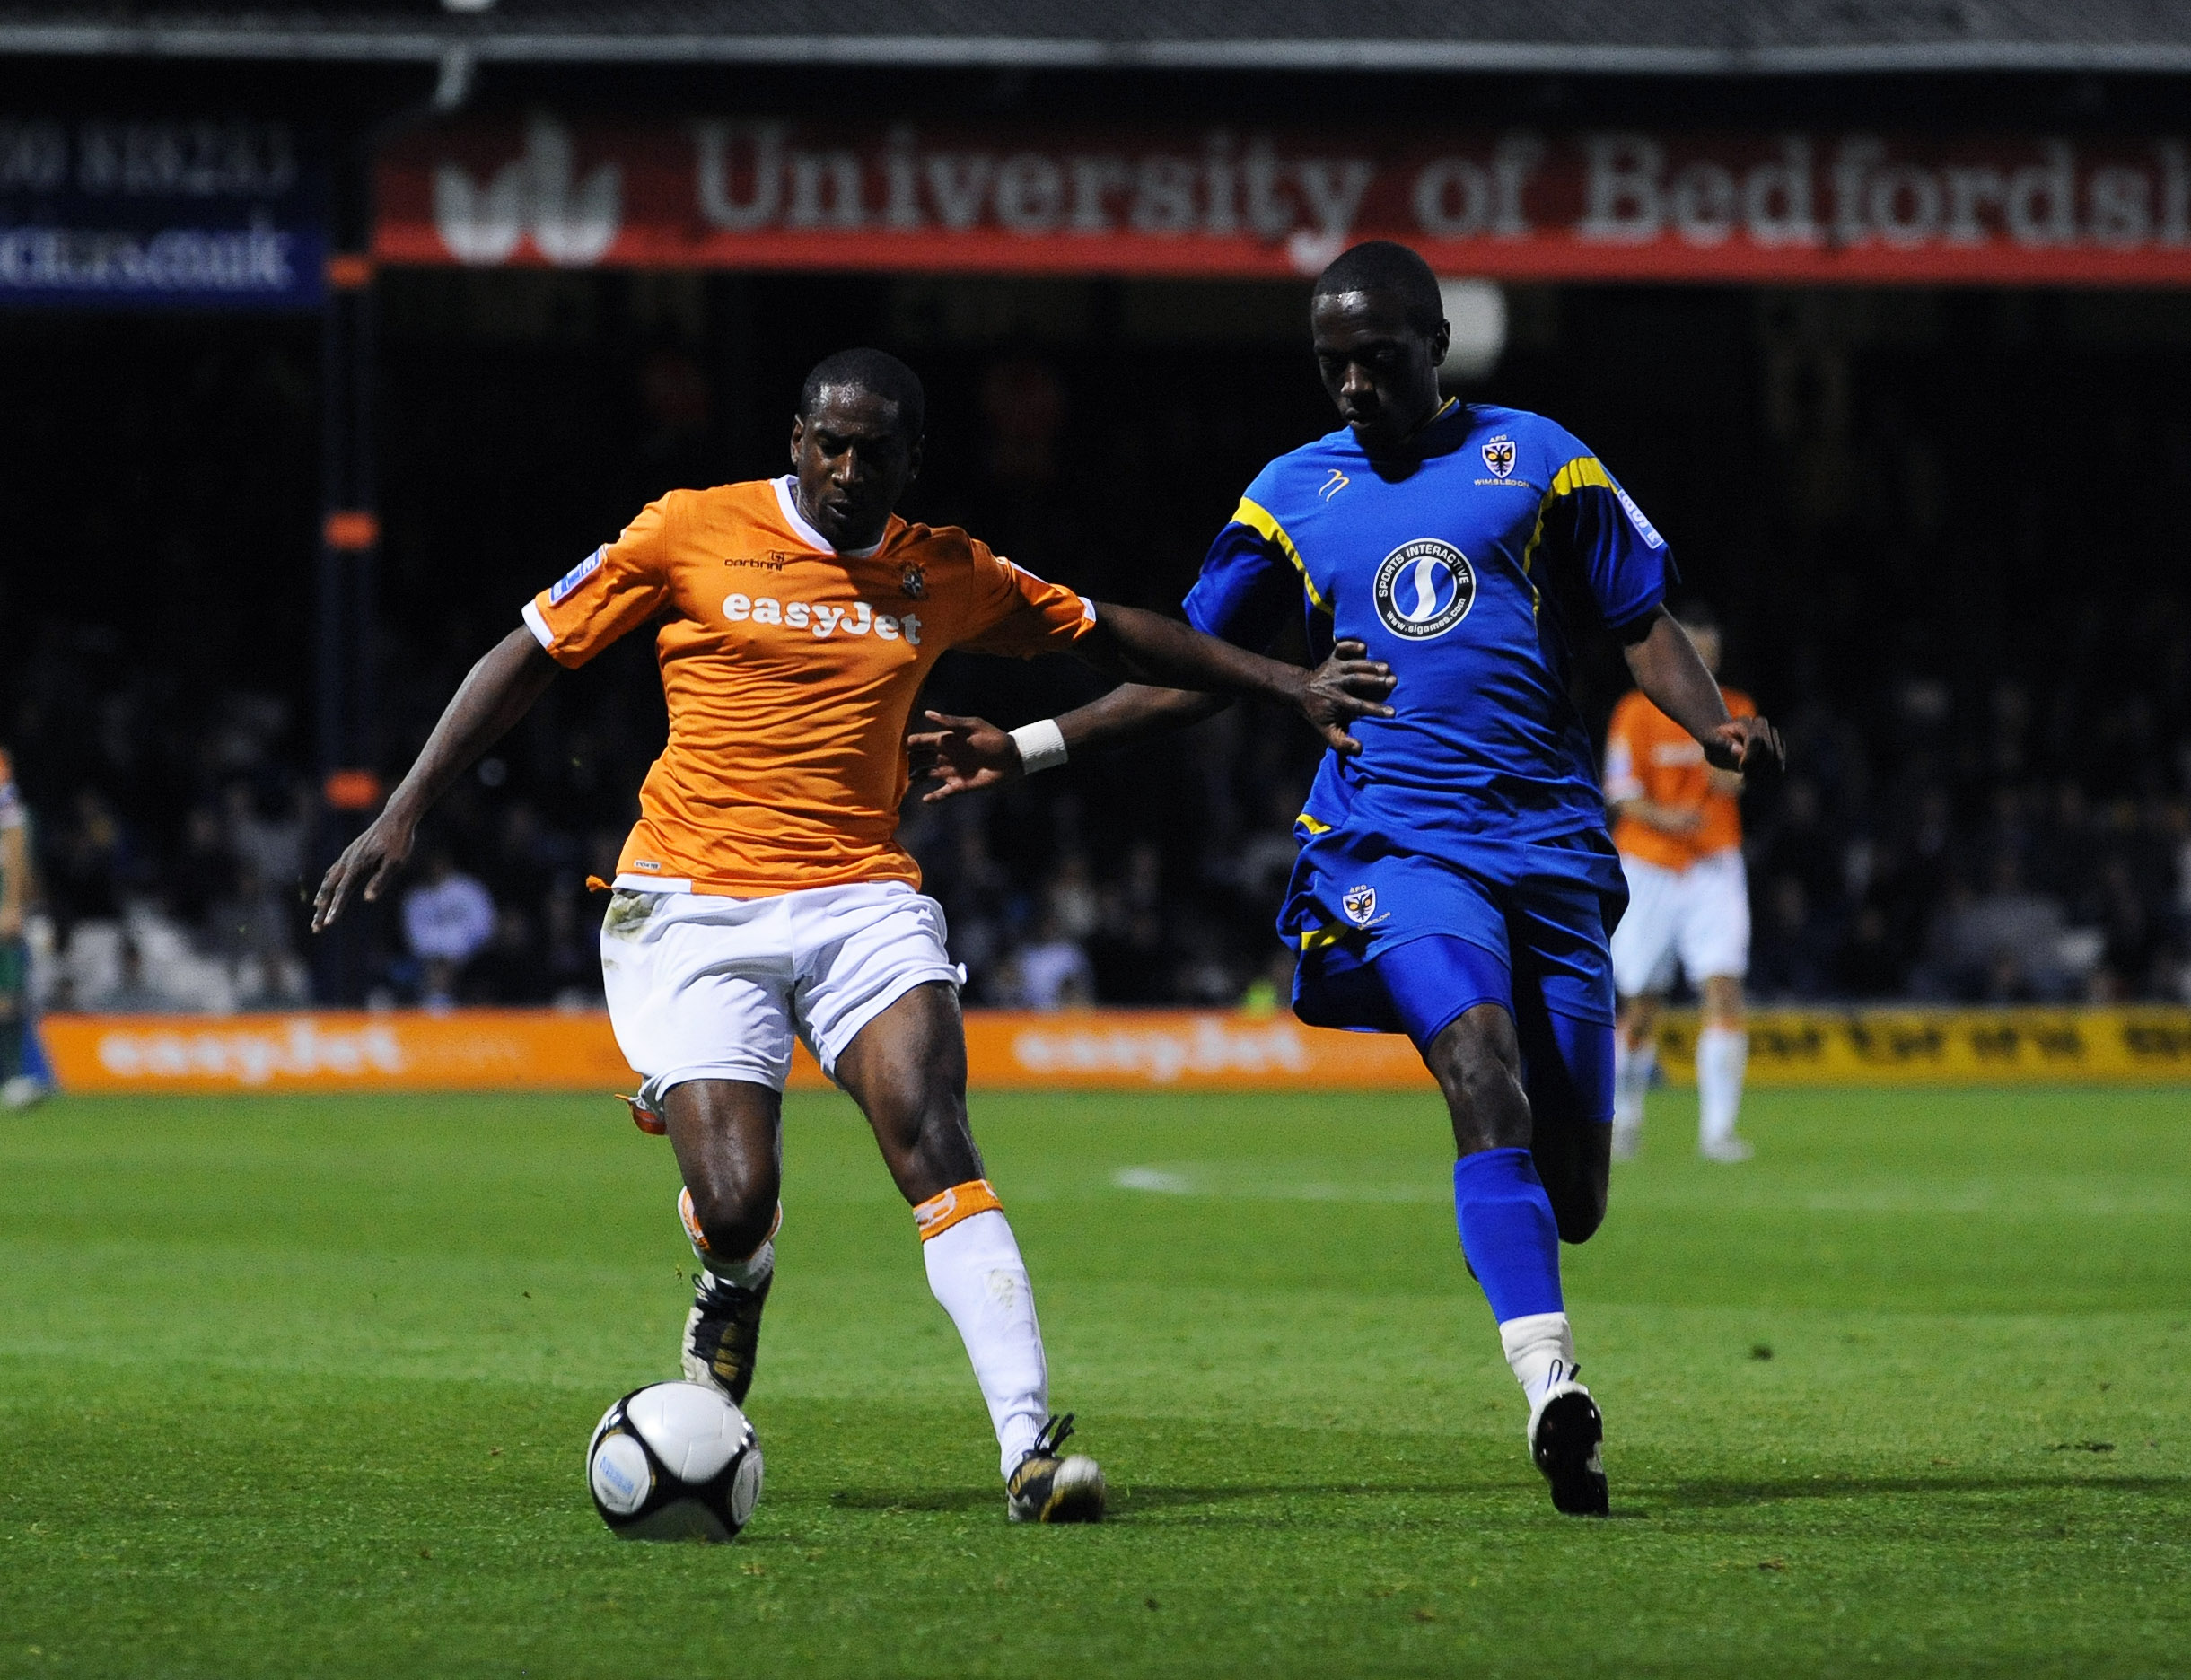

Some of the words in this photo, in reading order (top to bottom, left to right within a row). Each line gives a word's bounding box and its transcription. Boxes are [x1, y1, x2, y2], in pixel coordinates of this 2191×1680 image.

[691, 120, 1375, 275] University
[1412, 129, 1546, 241] of
[1474, 478, 1529, 488] WIMBLEDON
[1379, 554, 1405, 598] SPORTS
[1406, 544, 1469, 584] INTERACTIVE
[722, 593, 922, 644] easyJet
